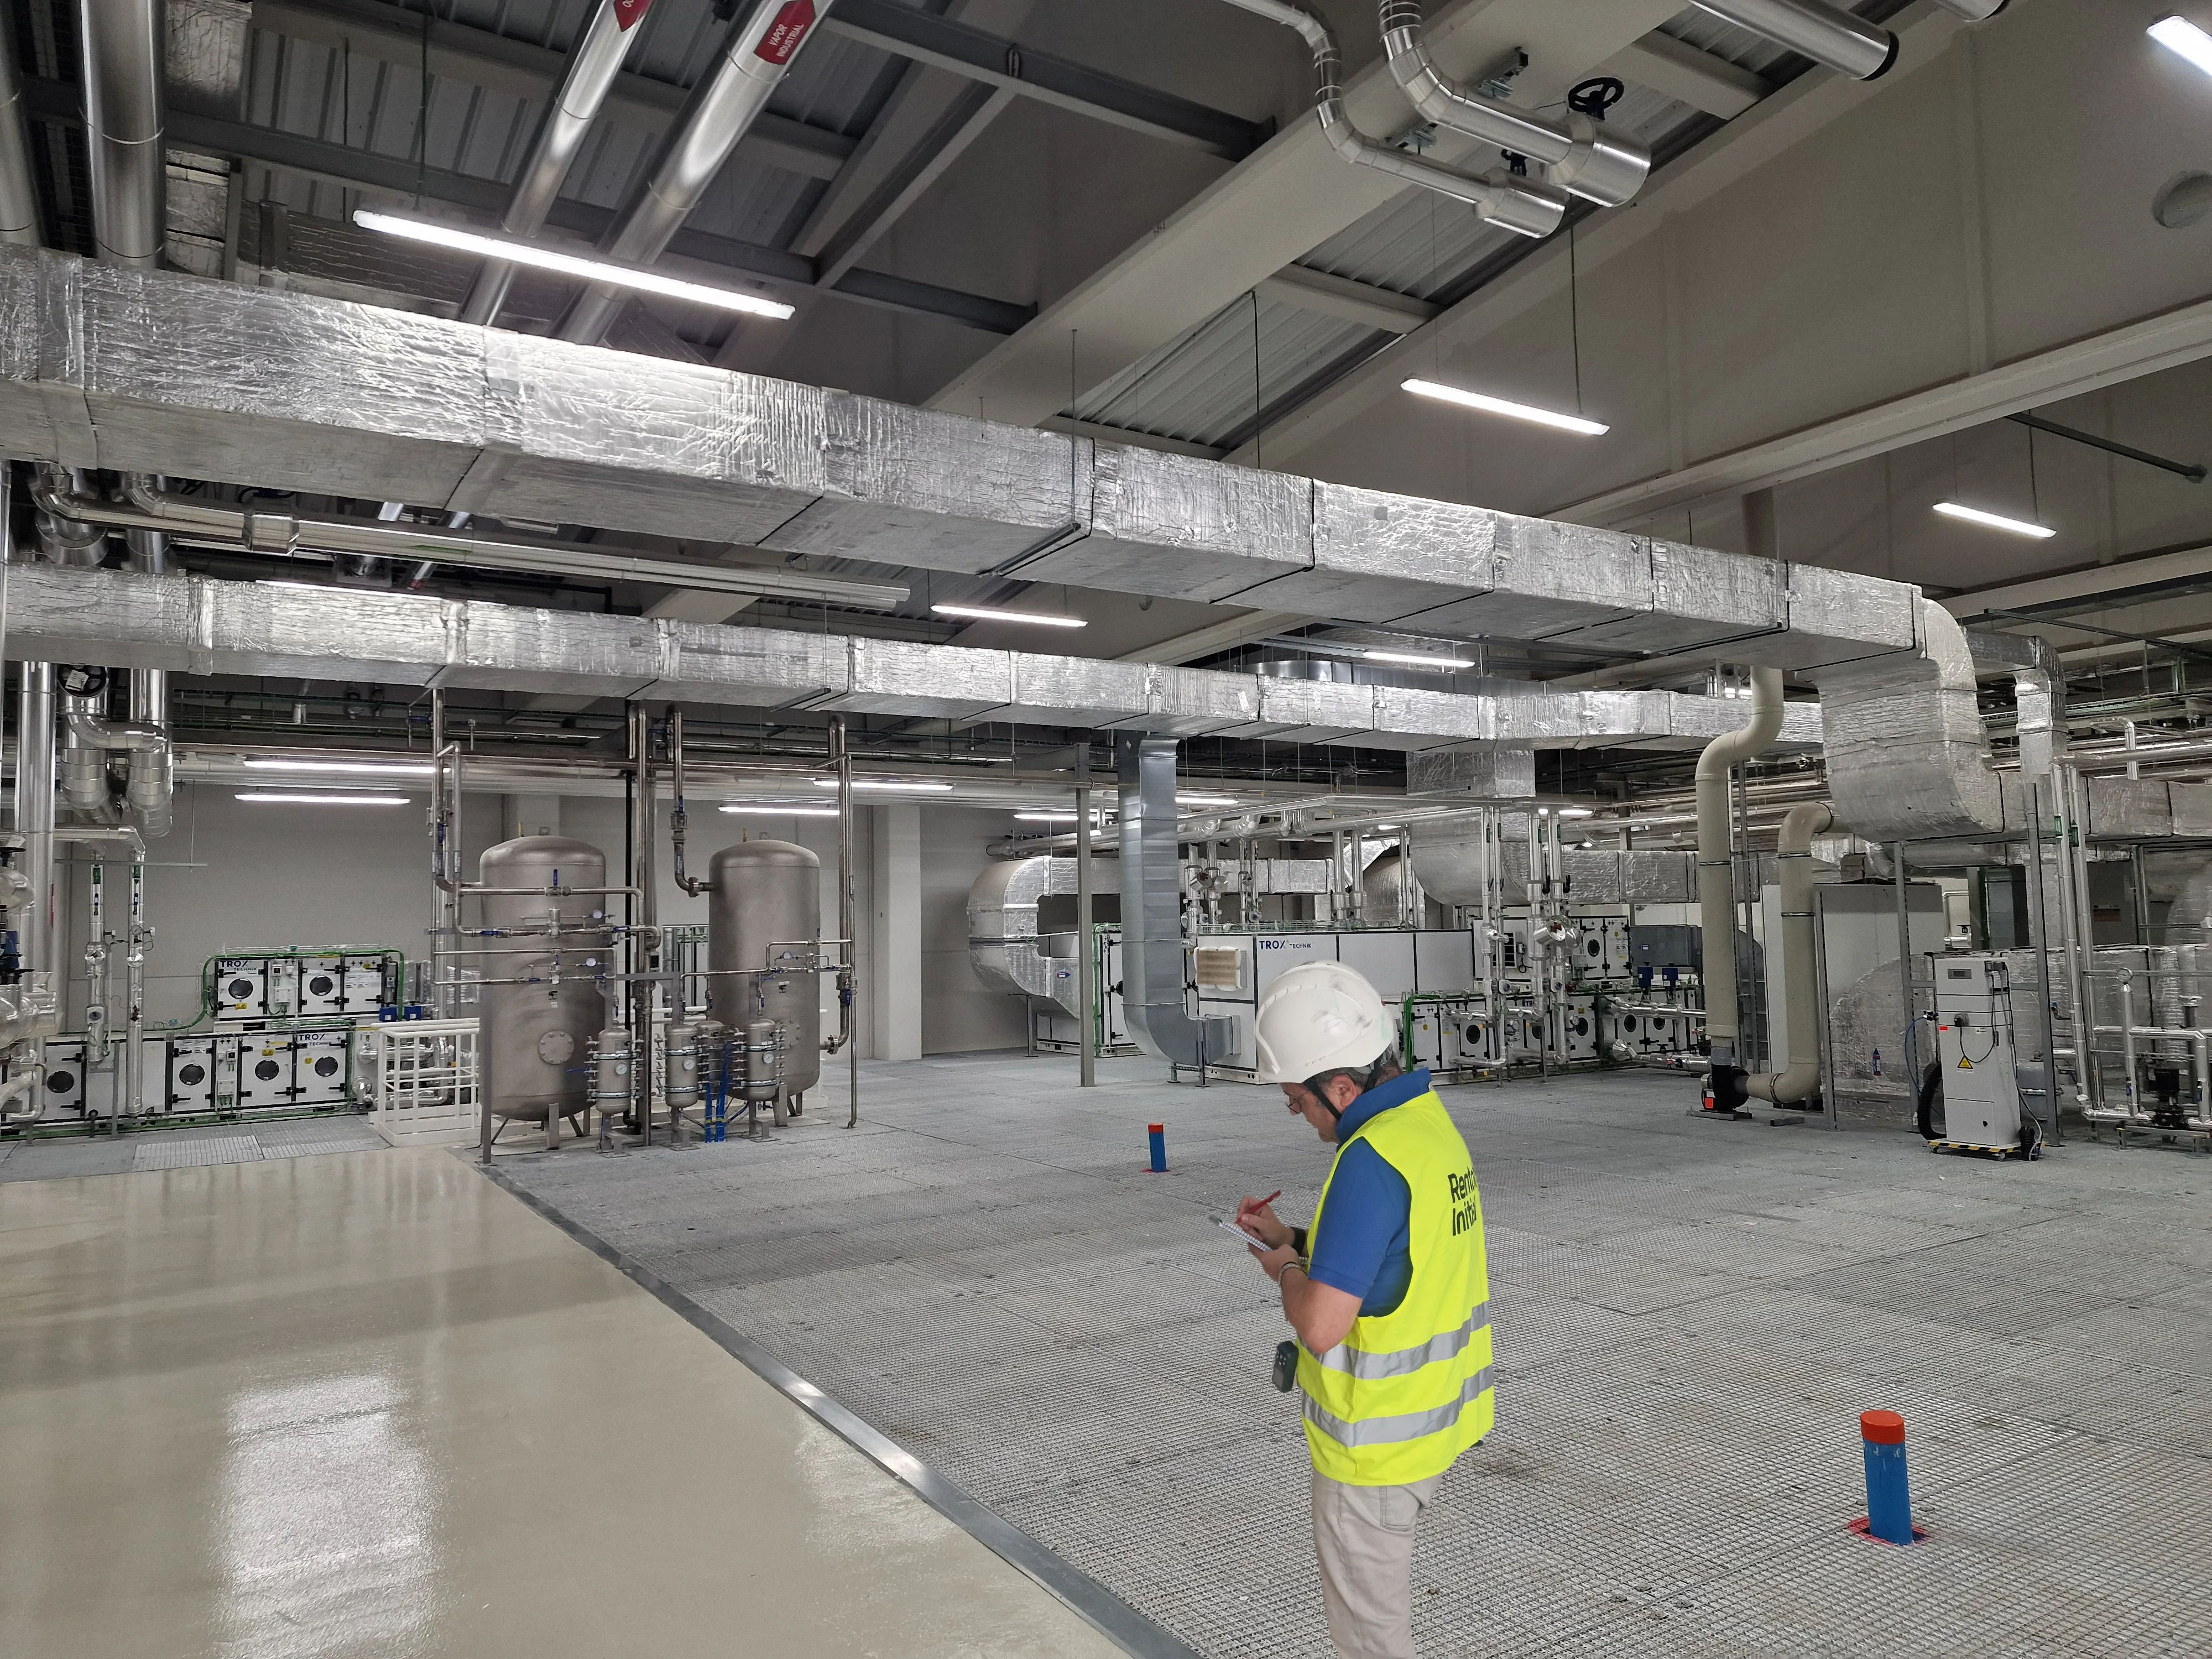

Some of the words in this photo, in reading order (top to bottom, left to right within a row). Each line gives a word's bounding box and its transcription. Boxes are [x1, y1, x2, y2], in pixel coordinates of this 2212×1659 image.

[768, 24, 788, 46] VAPOR
[776, 24, 805, 57] INDUSTRIAL
[1259, 940, 1286, 950] TROX
[1452, 1194, 1477, 1237] Initial
